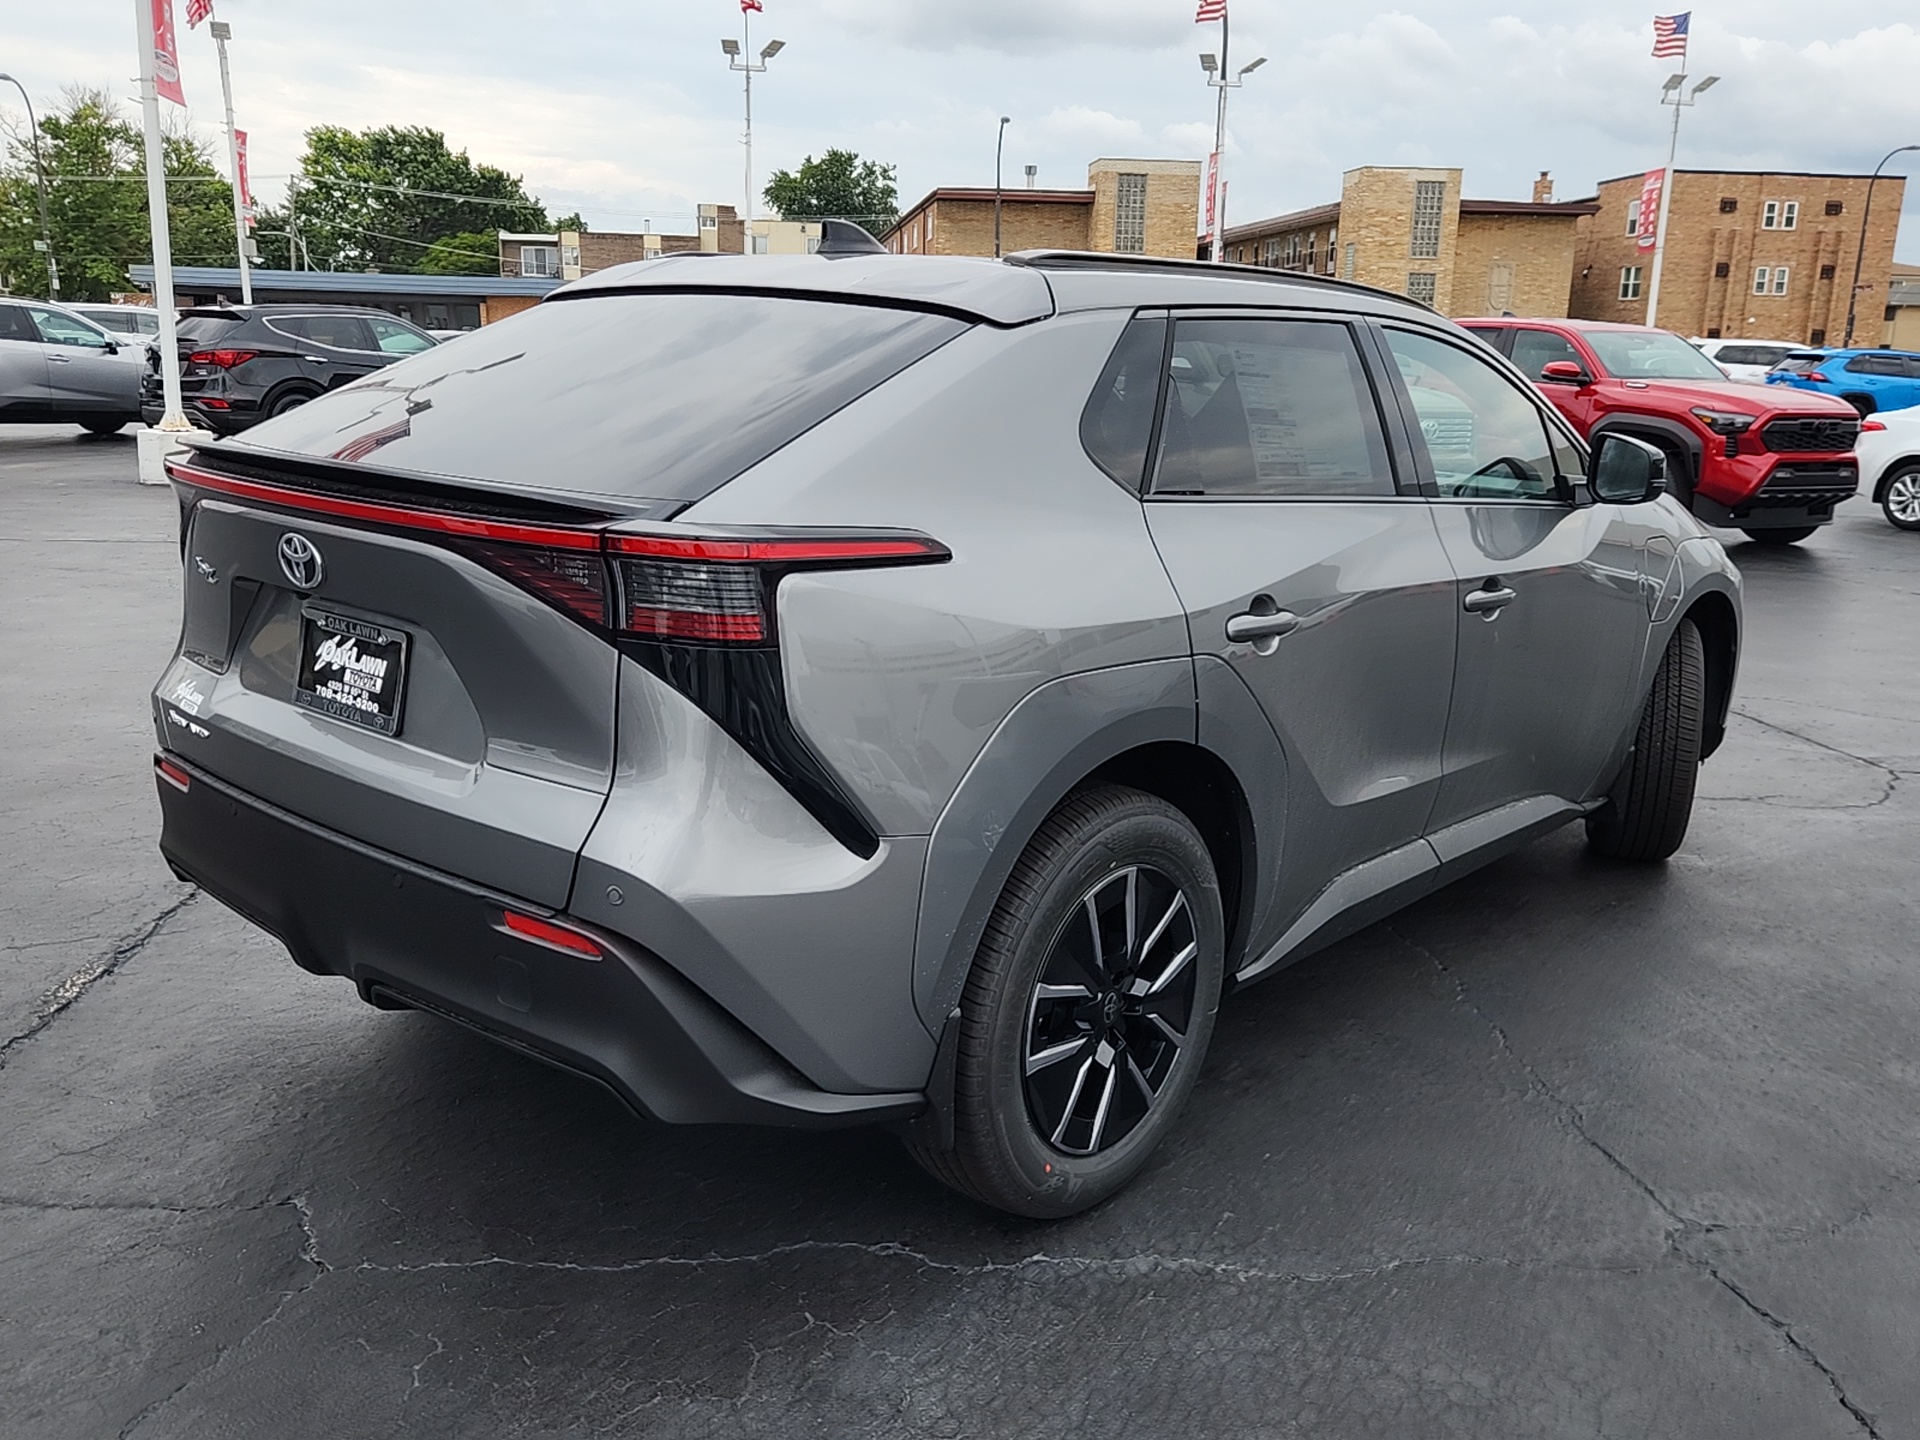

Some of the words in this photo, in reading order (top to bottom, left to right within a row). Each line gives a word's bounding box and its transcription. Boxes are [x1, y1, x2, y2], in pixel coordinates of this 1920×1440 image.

[328, 617, 347, 632] OAK
[349, 623, 378, 639] LAWN
[349, 670, 378, 690] TOYOTA
[315, 684, 379, 713] 708-423-5200
[322, 700, 362, 722] TOYOTA
